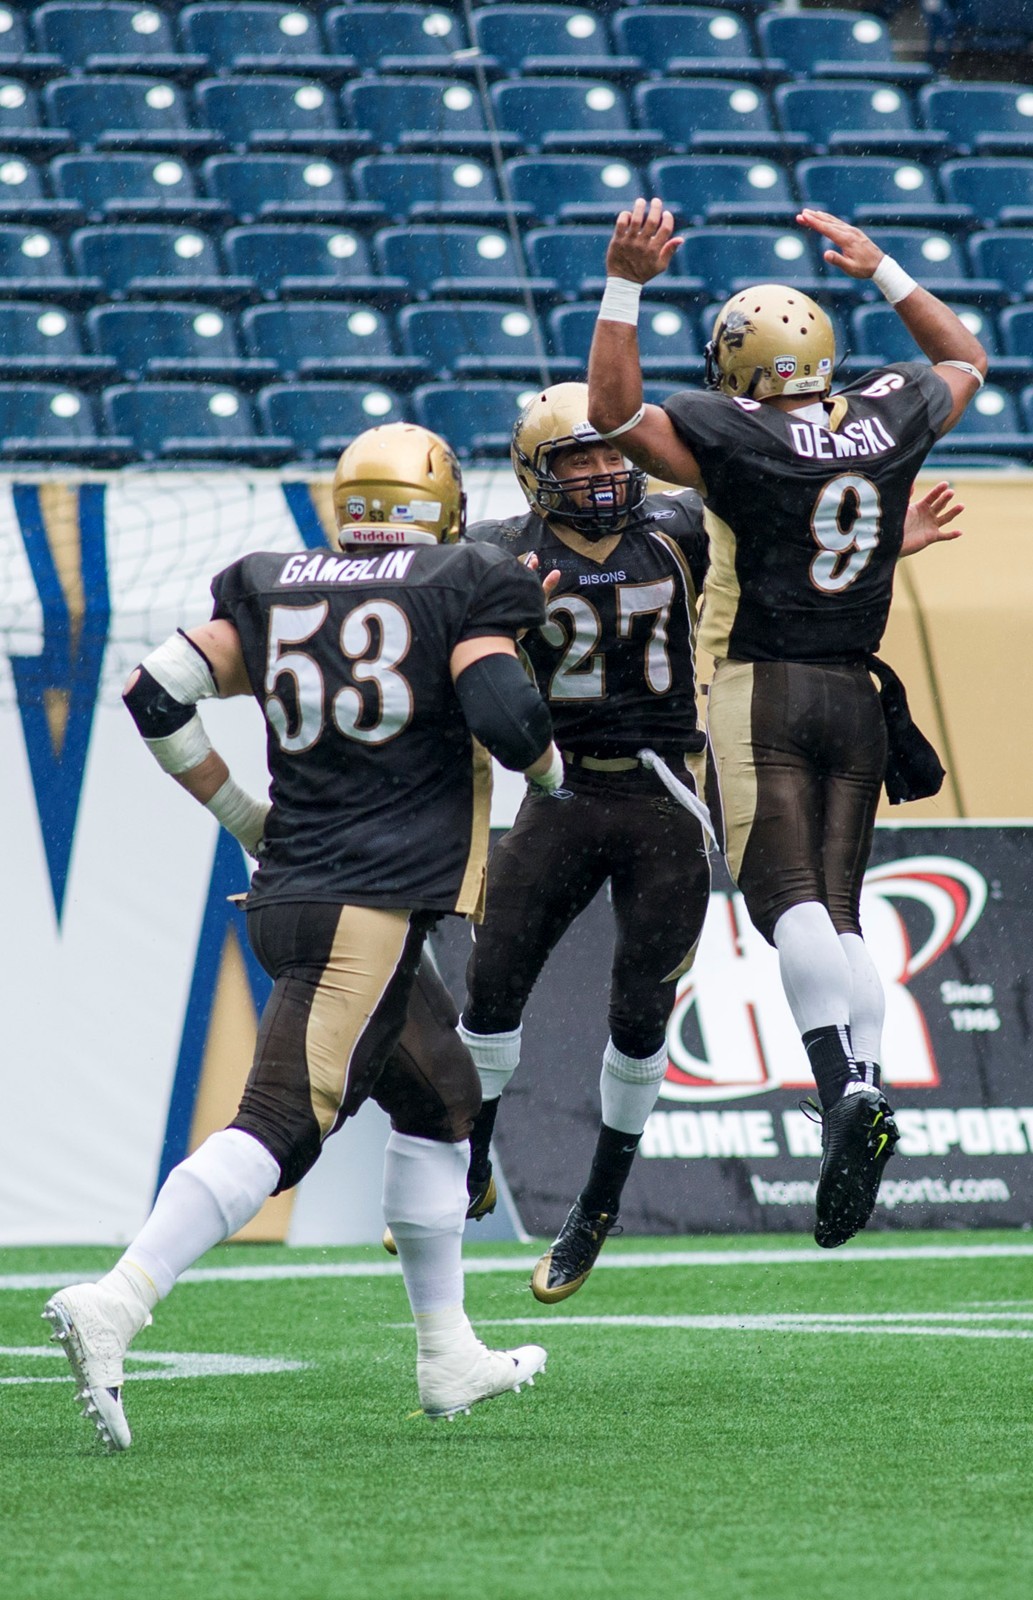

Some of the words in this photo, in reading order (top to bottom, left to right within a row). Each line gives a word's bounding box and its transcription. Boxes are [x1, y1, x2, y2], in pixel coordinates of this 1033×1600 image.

[777, 362, 795, 373] 50
[803, 364, 811, 376] 9
[789, 416, 897, 460] DEMSKI
[348, 504, 365, 515] 50
[352, 530, 405, 543] Riddell
[809, 472, 882, 593] 9
[279, 549, 415, 585] GAMBLIN
[578, 570, 627, 586] BISONS
[540, 575, 676, 703] 27
[264, 598, 414, 755] 53
[640, 1109, 779, 1158] HOME
